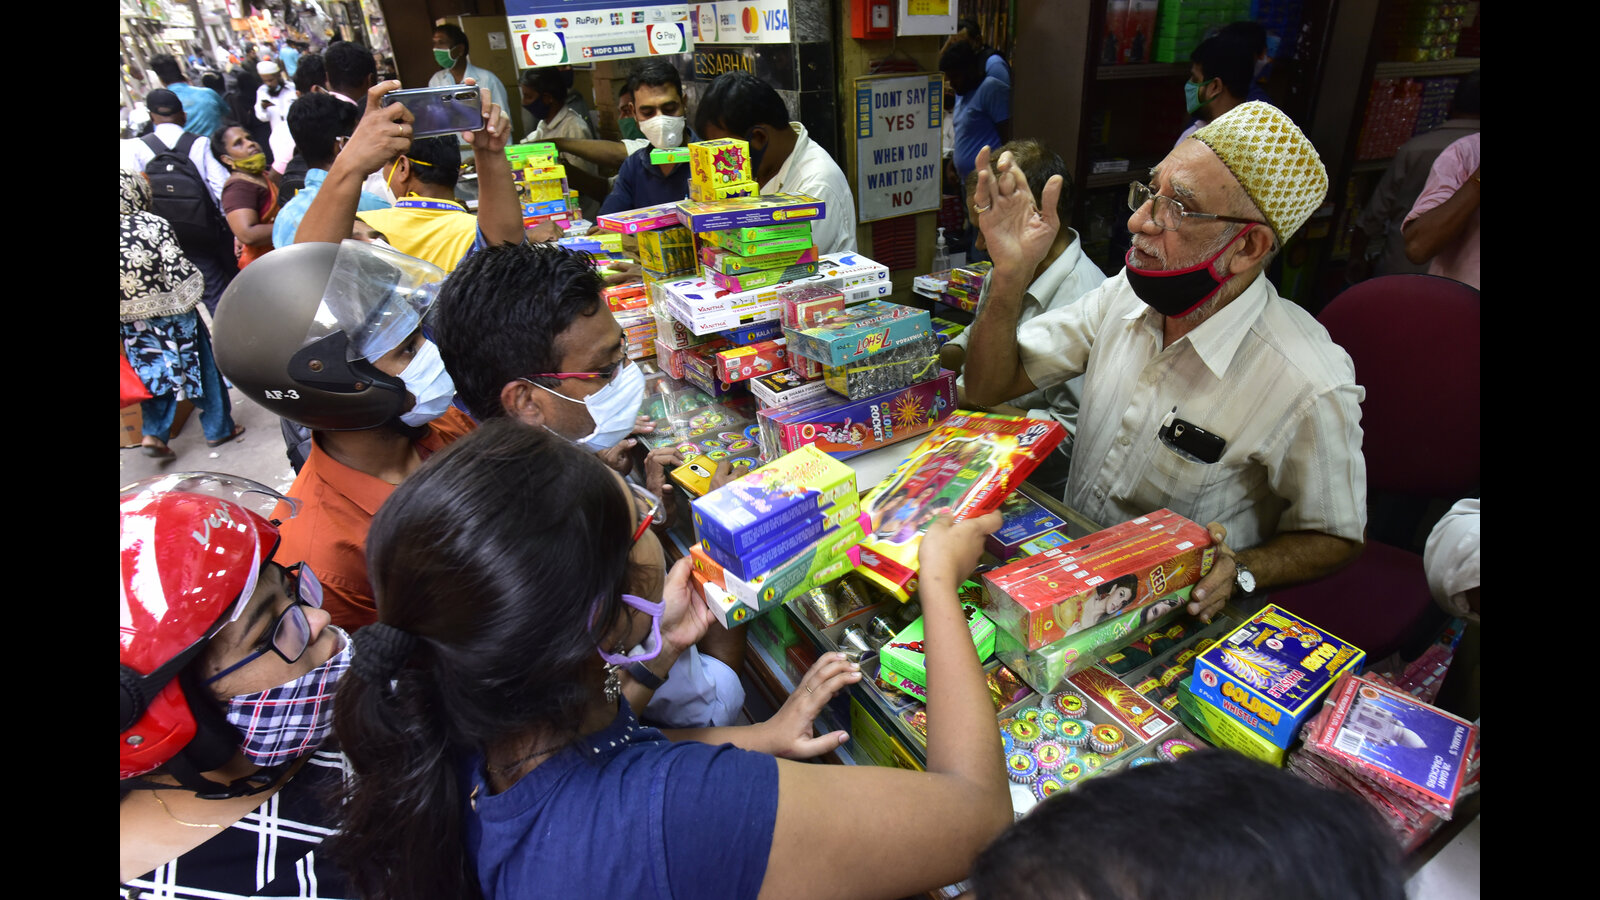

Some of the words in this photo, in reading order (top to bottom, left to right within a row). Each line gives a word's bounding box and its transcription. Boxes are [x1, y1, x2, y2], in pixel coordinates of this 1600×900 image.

[576, 16, 598, 26] RuPay
[762, 9, 789, 31] VISA
[533, 41, 541, 51] G
[542, 41, 556, 51] Pay
[656, 31, 663, 40] G
[664, 31, 677, 40] Pay
[593, 47, 612, 55] HDFC
[613, 45, 633, 53] BANK
[875, 90, 902, 109] DONT
[907, 87, 927, 104] SAY
[873, 147, 904, 165] WHEN
[908, 142, 928, 160] YOU
[867, 170, 898, 190] WANT
[901, 169, 914, 185] TO
[915, 164, 935, 182] SAY
[854, 335, 882, 356] SHOT
[264, 389, 300, 400] AF-3
[869, 405, 884, 443] ROCKET
[880, 402, 893, 440] COLOUR
[1150, 565, 1167, 596] RED
[1299, 642, 1339, 673] GOLDEN
[1266, 669, 1305, 699] WHISTLE
[1220, 681, 1282, 725] GOLDEN
[1223, 700, 1258, 728] WHISTLE
[1426, 755, 1443, 789] CRACKERS
[1438, 770, 1450, 790] GIANT
